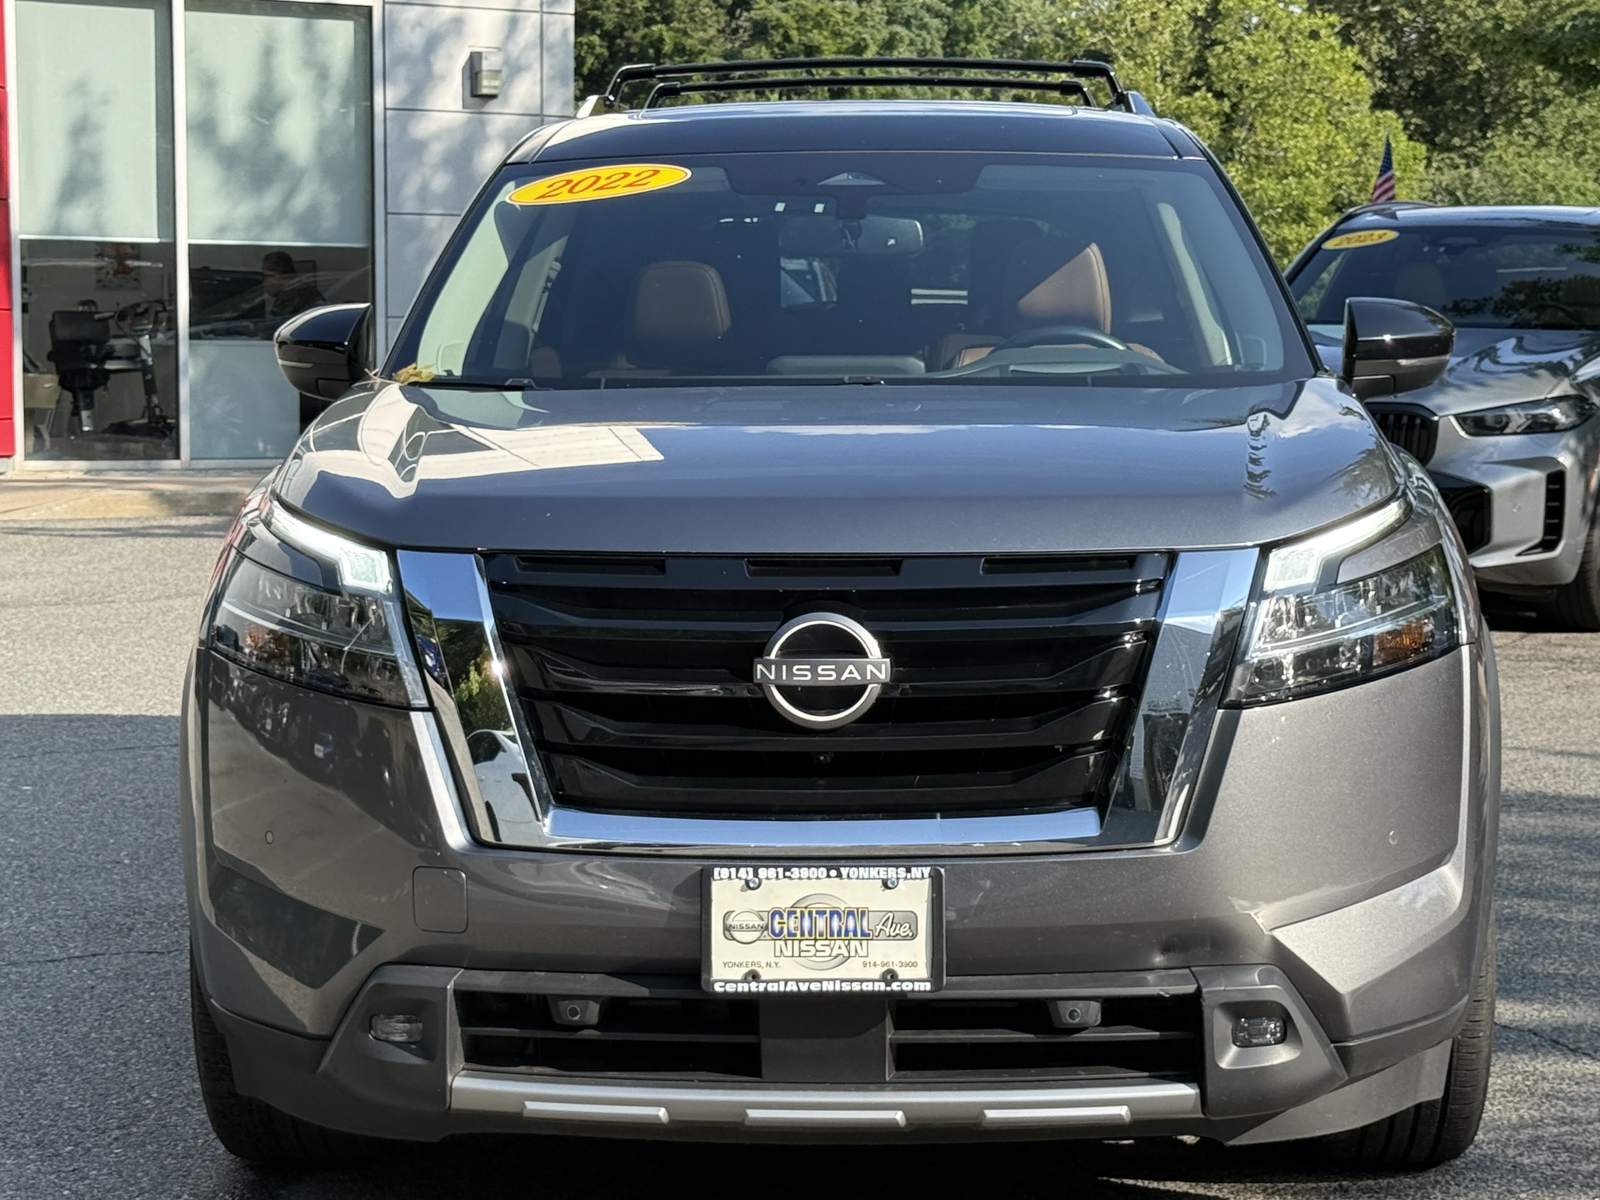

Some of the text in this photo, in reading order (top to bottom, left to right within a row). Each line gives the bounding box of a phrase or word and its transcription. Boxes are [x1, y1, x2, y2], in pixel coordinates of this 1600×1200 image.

[534, 169, 661, 200] 2022
[756, 663, 886, 681] NISSAN
[758, 867, 828, 880] 961-3900
[768, 907, 914, 939] CENTRAL Ave.
[774, 939, 869, 958] NISSAN
[722, 961, 781, 970] YONKERS, N.Y.
[862, 960, 918, 969] 914-961-3900
[713, 980, 932, 993] CentralAveNissan.com
